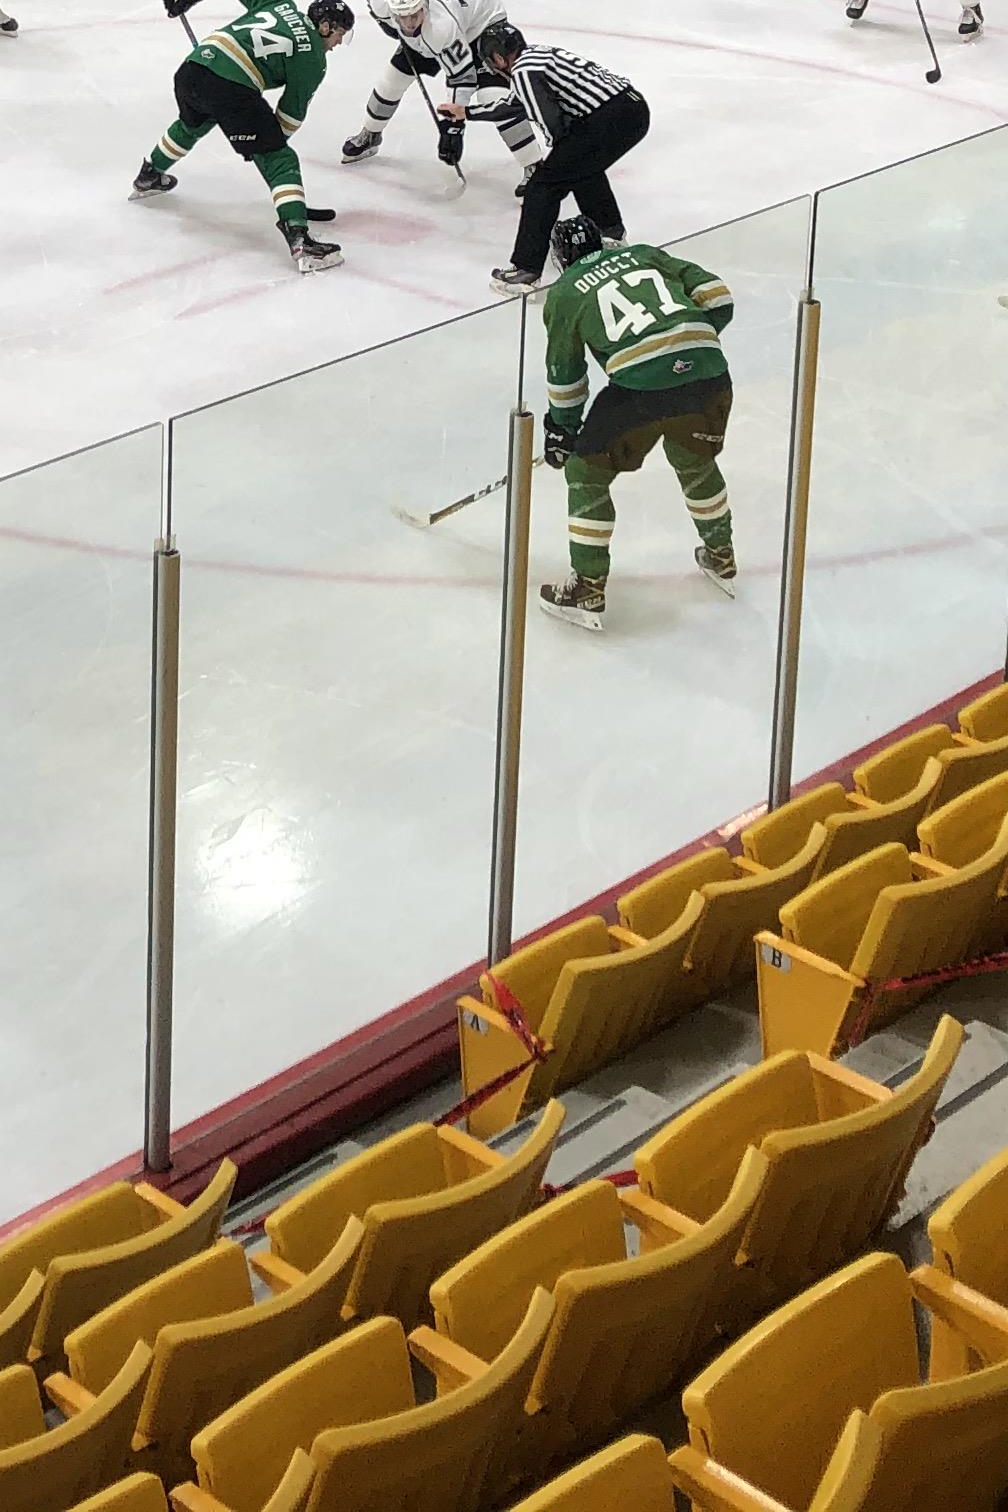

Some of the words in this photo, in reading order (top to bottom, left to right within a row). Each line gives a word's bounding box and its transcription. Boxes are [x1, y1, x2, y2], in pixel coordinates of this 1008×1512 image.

[231, 11, 294, 60] 74
[273, 2, 312, 52] GAUCHER
[441, 38, 470, 67] 12
[571, 231, 586, 245] 47
[573, 250, 640, 295] DOUCET
[596, 268, 688, 343] 47
[771, 949, 783, 968] B
[469, 1012, 480, 1032] A
